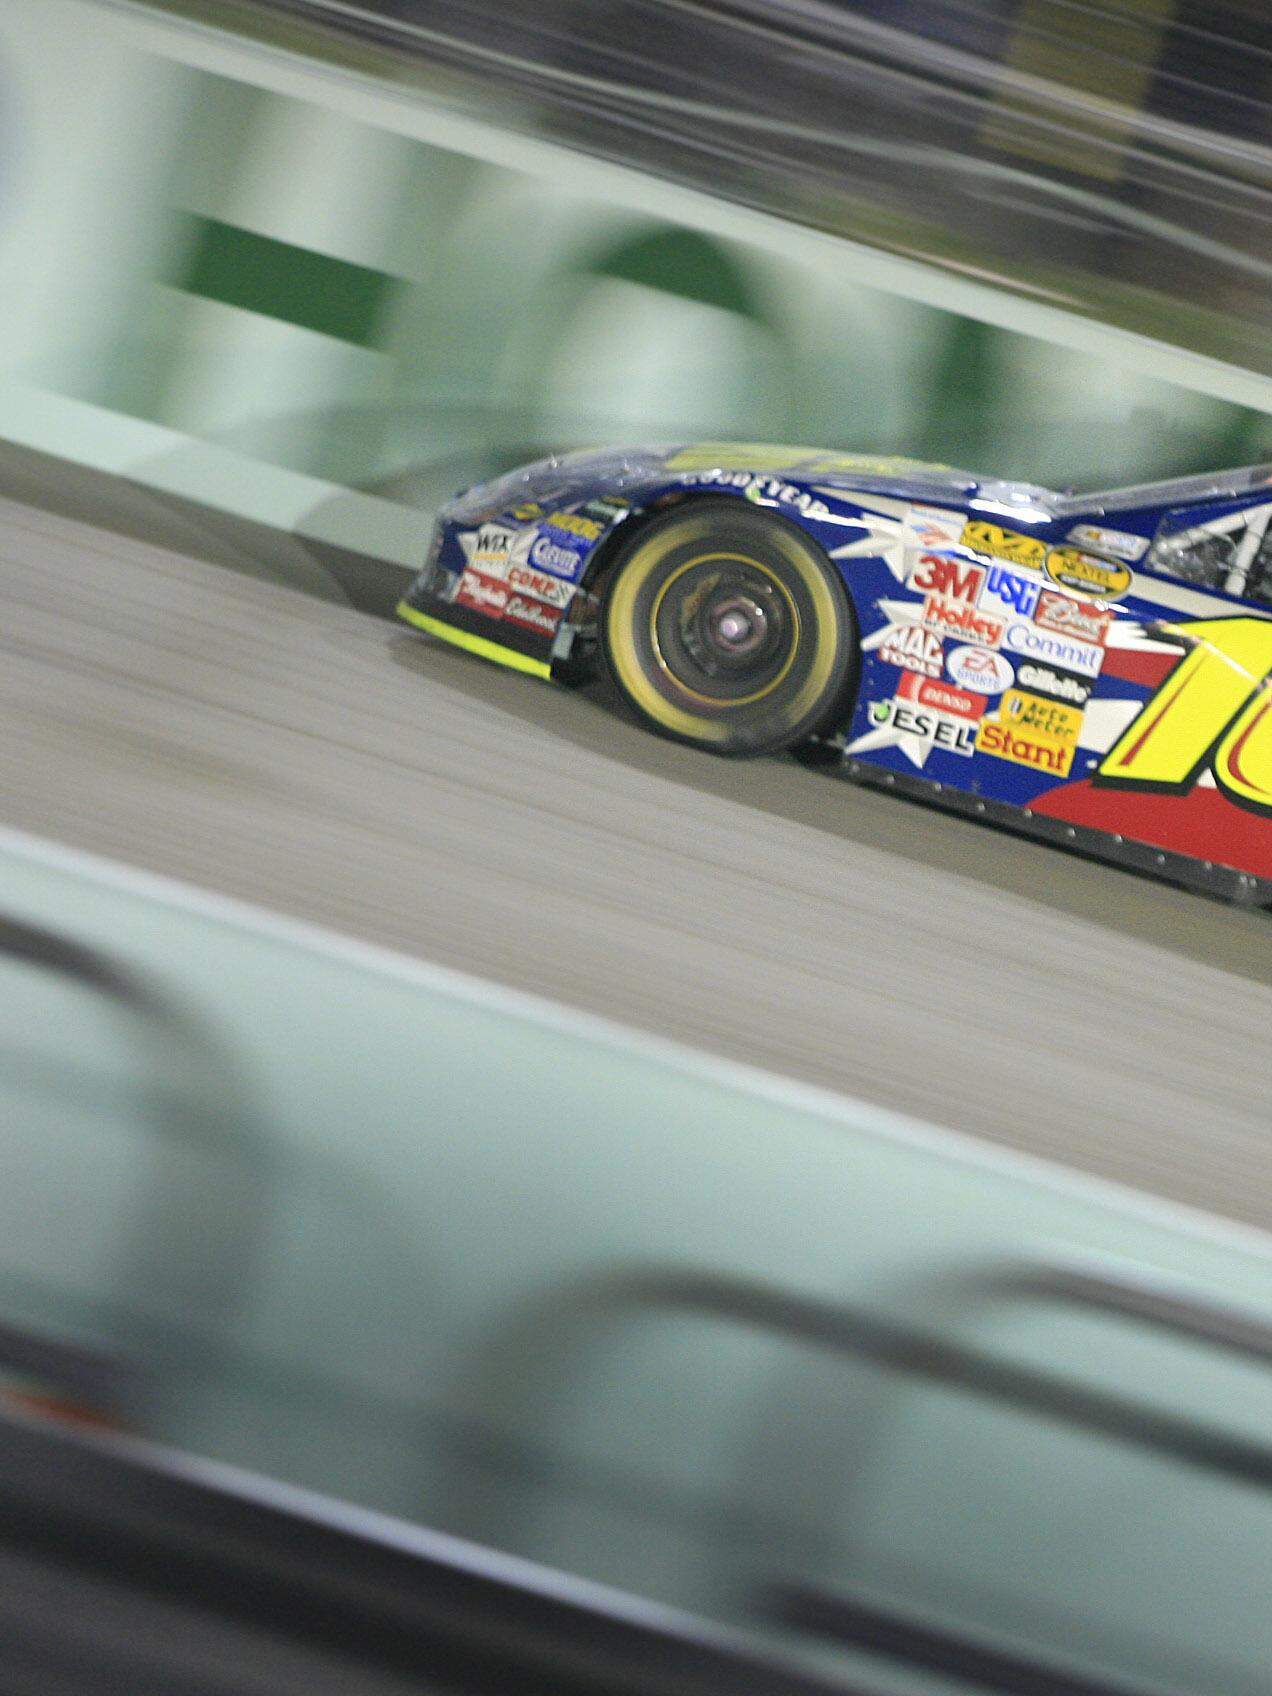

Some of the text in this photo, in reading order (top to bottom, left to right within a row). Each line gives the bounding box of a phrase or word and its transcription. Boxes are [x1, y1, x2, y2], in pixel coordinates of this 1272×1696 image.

[477, 533, 509, 552] WIX
[914, 555, 983, 604] 3M
[987, 562, 1038, 616] USG
[927, 597, 1002, 645] Holley
[964, 648, 999, 677] EA
[1006, 624, 1099, 670] Commit
[980, 723, 1068, 771] Stant
